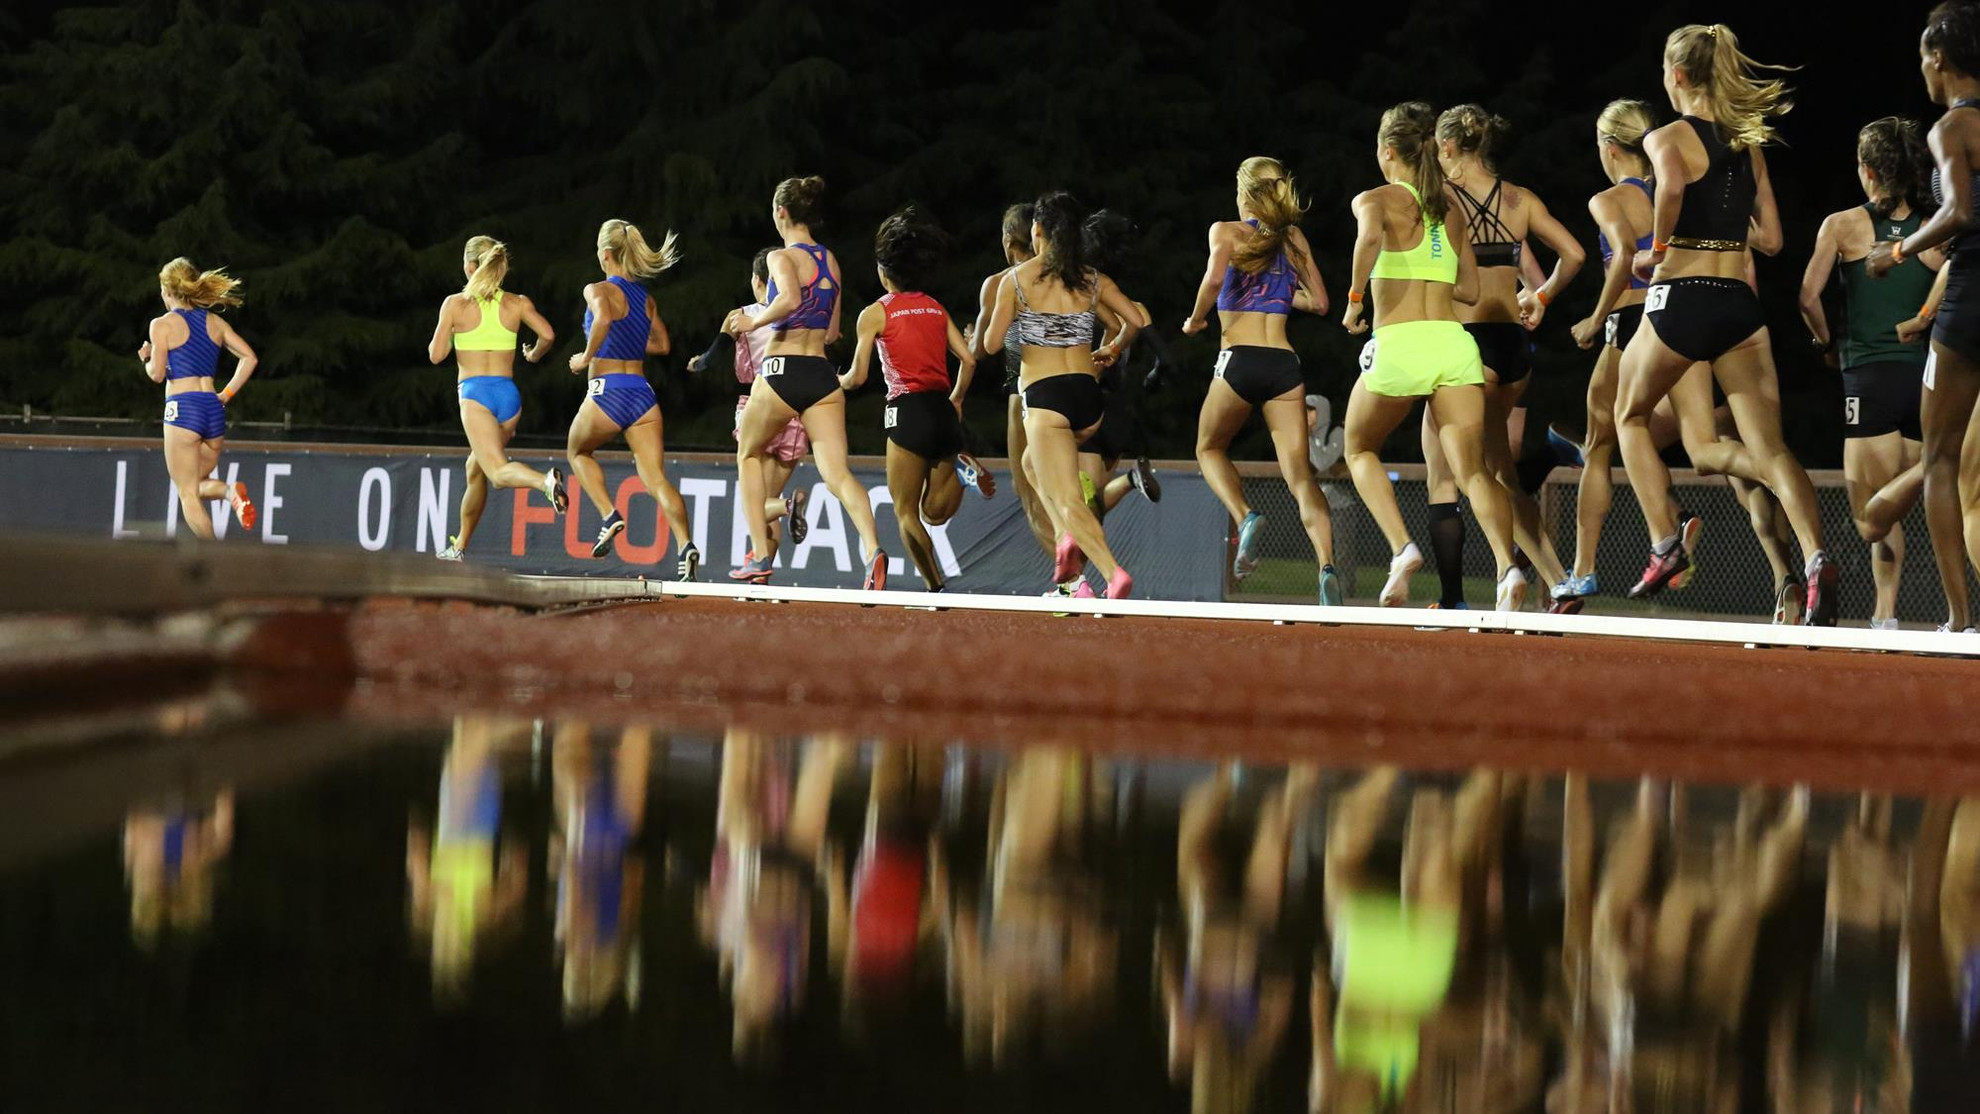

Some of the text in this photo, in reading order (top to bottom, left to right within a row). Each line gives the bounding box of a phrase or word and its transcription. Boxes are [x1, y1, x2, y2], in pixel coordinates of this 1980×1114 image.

[767, 358, 780, 374] 10
[113, 460, 292, 545] LIVE
[358, 466, 451, 553] ON
